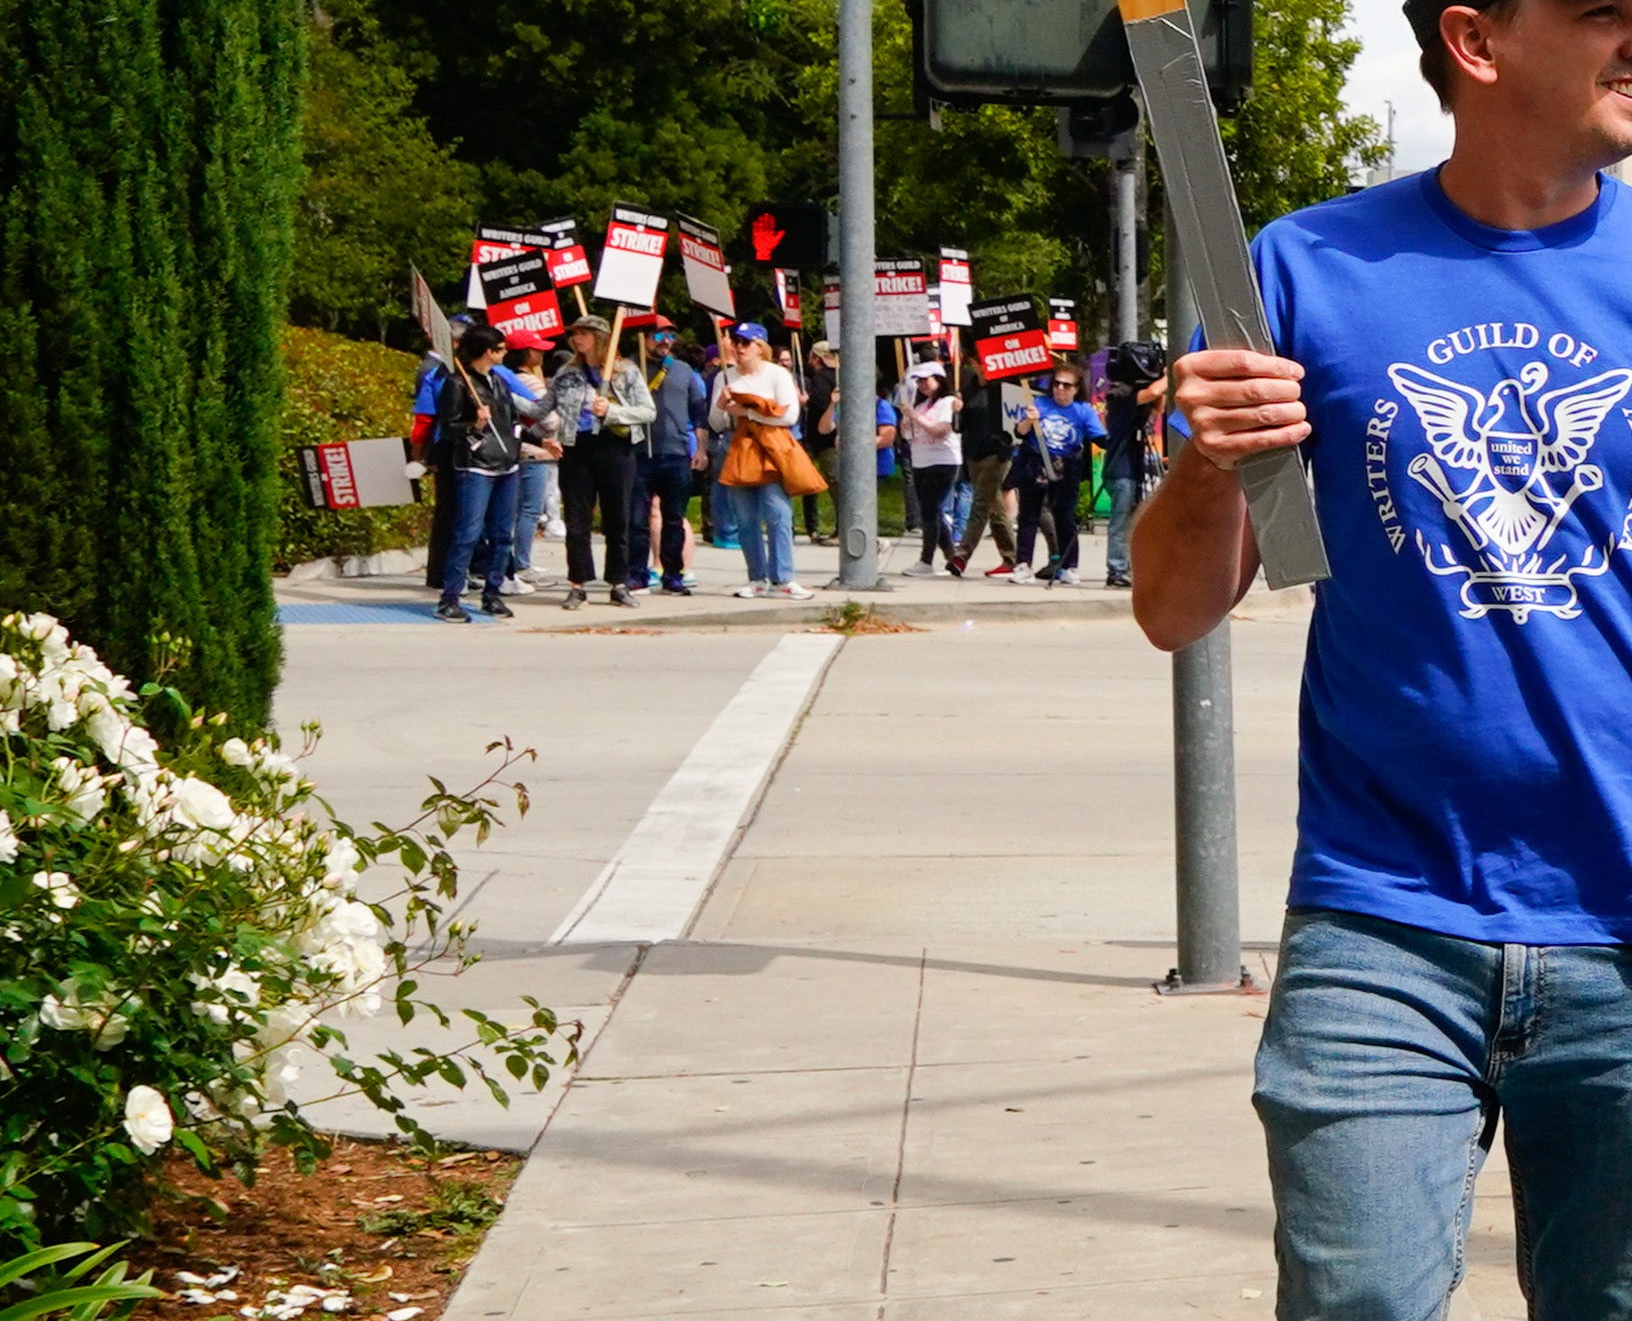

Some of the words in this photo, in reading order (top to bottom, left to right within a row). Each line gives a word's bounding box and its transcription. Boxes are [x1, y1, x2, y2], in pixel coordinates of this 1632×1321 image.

[610, 227, 665, 255] STRIKE!
[1004, 338, 1020, 350] ON
[984, 345, 1047, 372] STRIKE!
[1366, 398, 1407, 555] WRITERS
[1426, 322, 1540, 365] GUILD
[1548, 332, 1599, 369] OF
[1491, 442, 1532, 454] united
[1501, 454, 1522, 466] we
[323, 447, 357, 506] STRIKE!
[1494, 464, 1530, 477] stand
[1491, 586, 1546, 603] WEST
